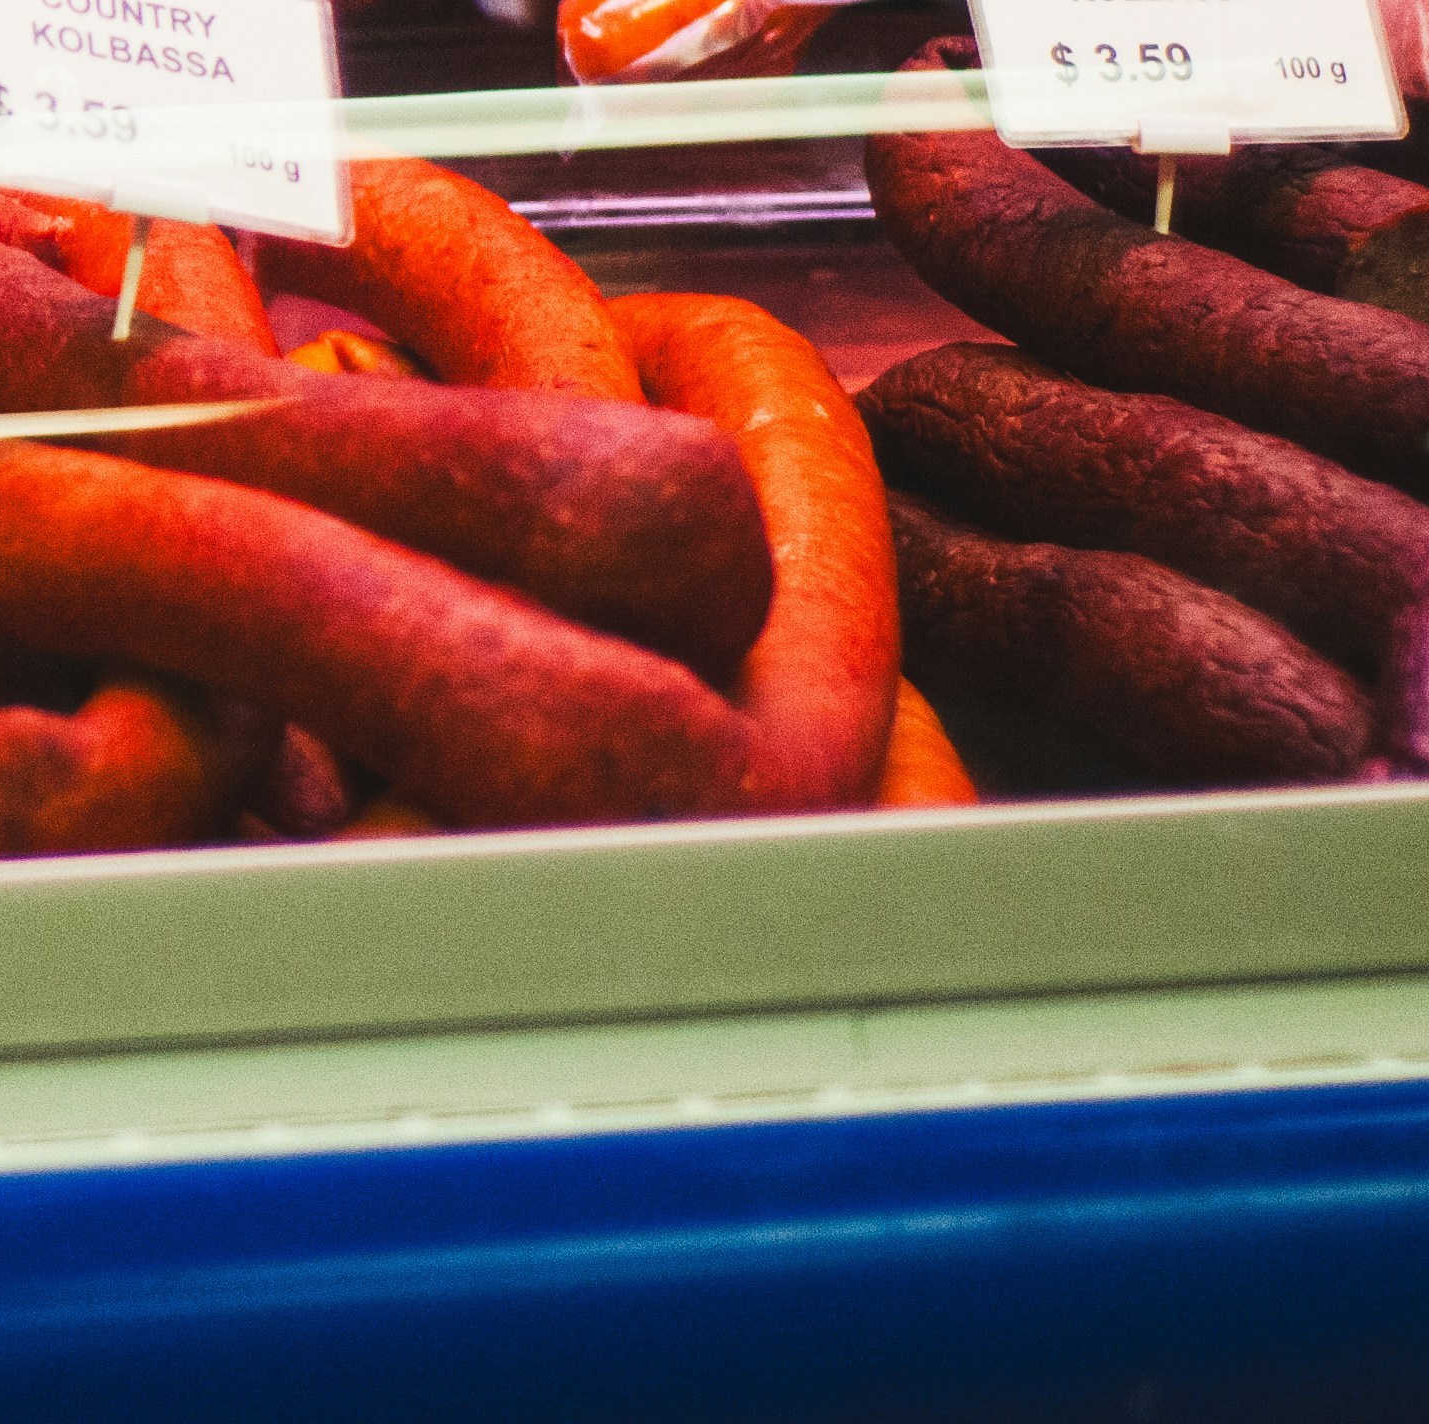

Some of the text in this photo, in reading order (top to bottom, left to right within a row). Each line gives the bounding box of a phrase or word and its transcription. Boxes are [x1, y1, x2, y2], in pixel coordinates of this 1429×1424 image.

[31, 21, 235, 84] KOLBASSA
[1050, 42, 1348, 87] $ 3.59 100 g
[34, 91, 138, 143] 3.59
[225, 141, 273, 171] 100
[282, 159, 300, 184] g
